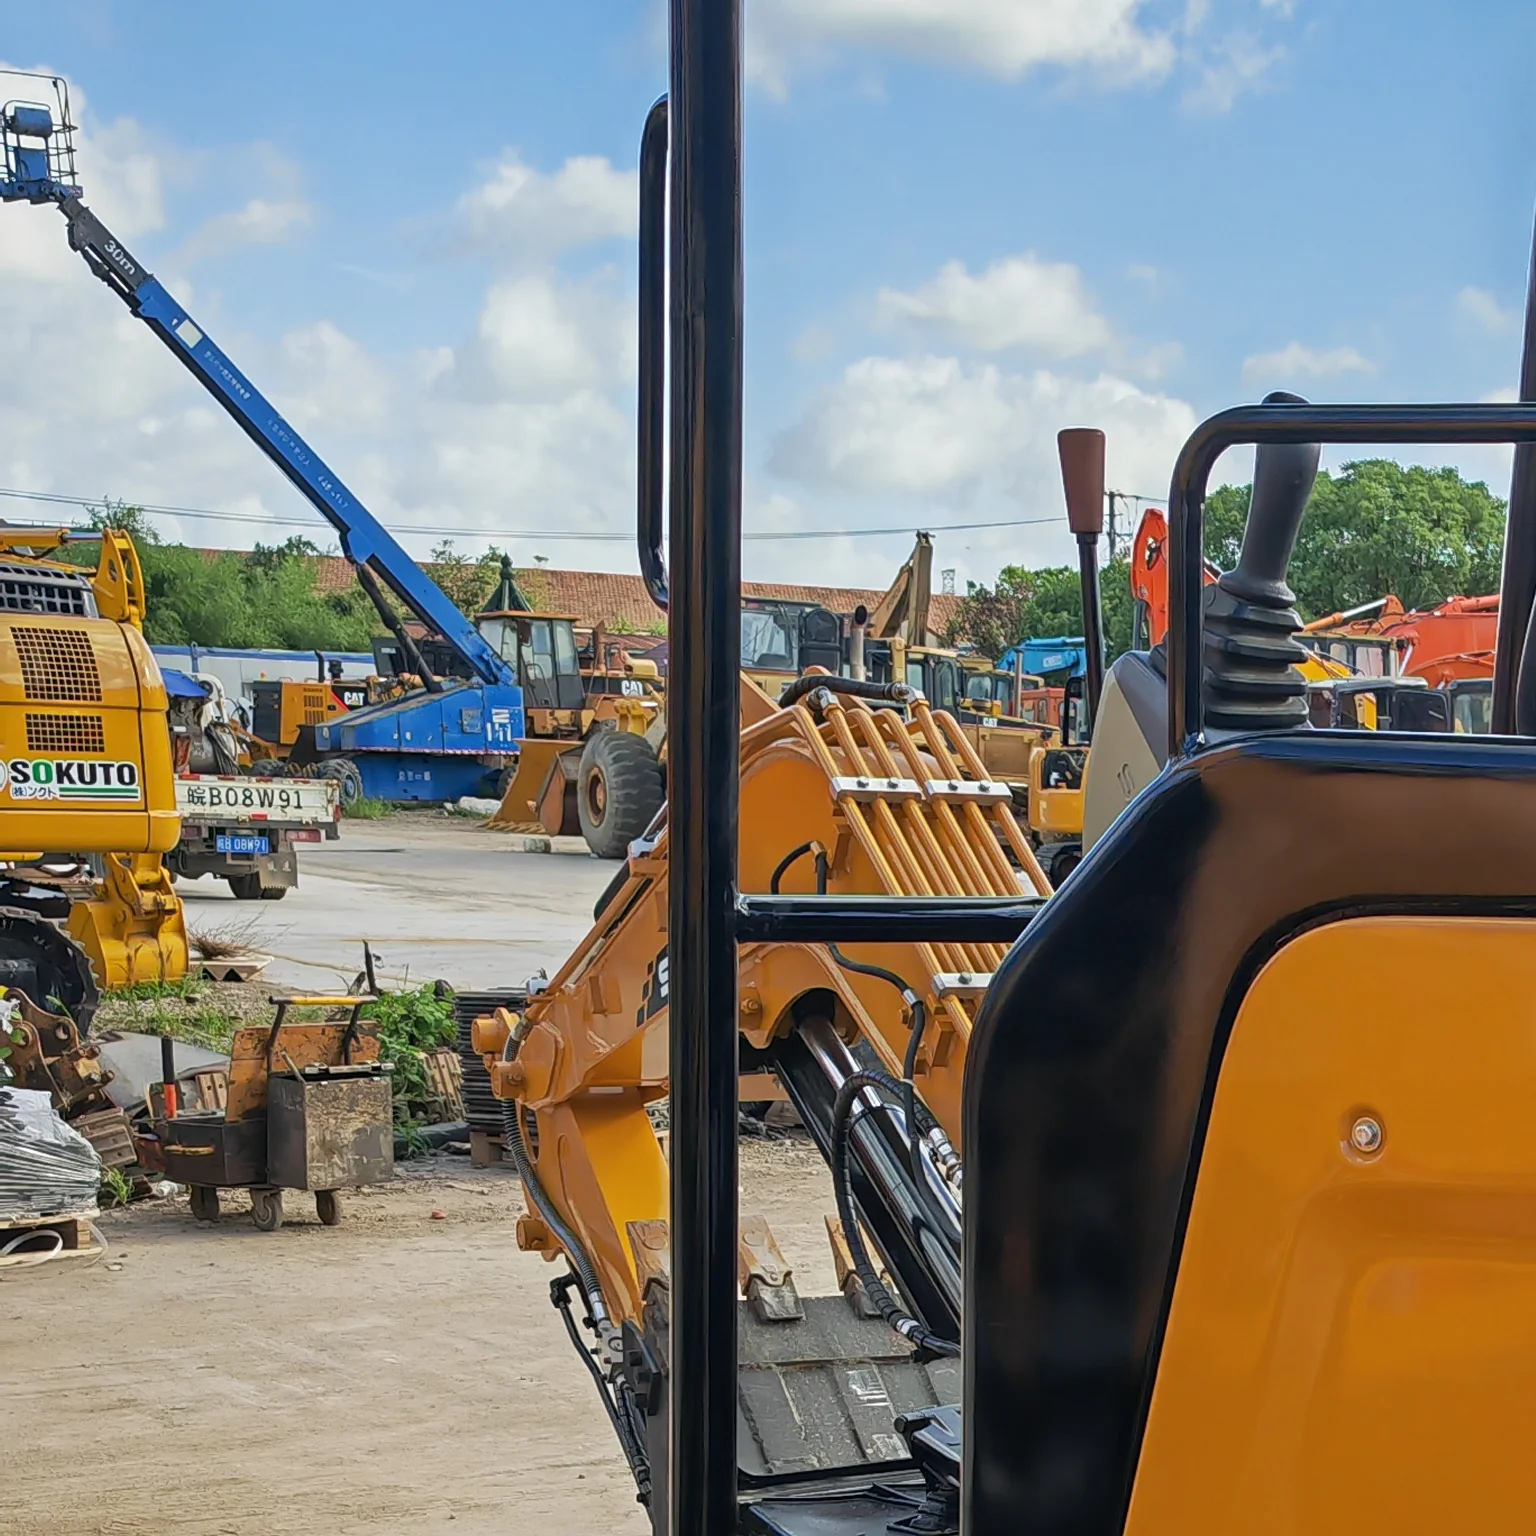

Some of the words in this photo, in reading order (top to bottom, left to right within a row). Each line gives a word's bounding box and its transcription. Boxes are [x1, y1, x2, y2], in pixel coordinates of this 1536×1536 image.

[104, 240, 136, 275] 30m
[344, 692, 365, 706] CAT
[621, 680, 643, 697] CAT
[10, 760, 138, 786] SOKUTO
[187, 787, 303, 809] 皖B08W91
